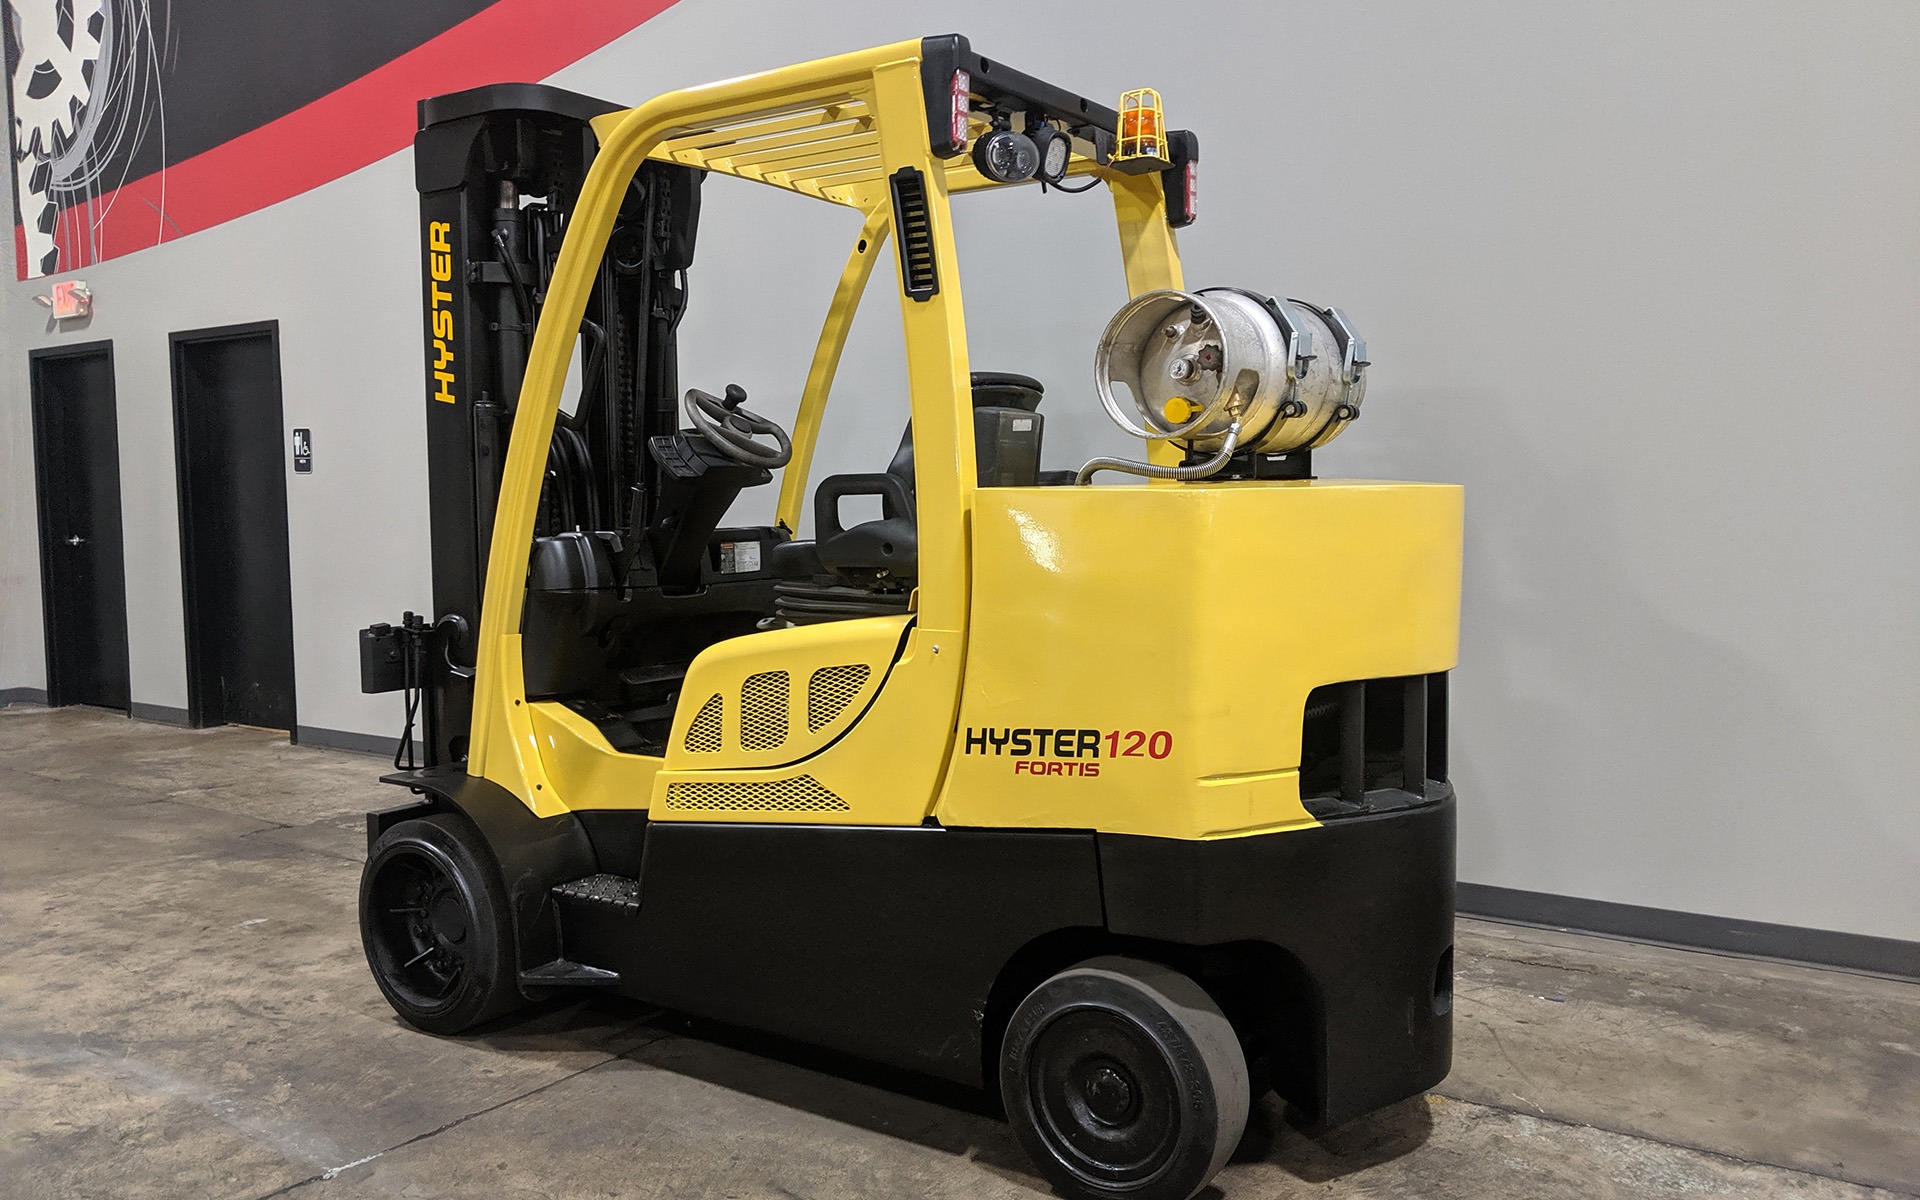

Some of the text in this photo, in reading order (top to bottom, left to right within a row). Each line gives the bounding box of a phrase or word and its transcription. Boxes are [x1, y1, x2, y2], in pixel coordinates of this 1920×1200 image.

[429, 220, 456, 405] HYSTER
[965, 727, 1173, 760] HYSTER 120
[1014, 760, 1100, 777] FORTIS
